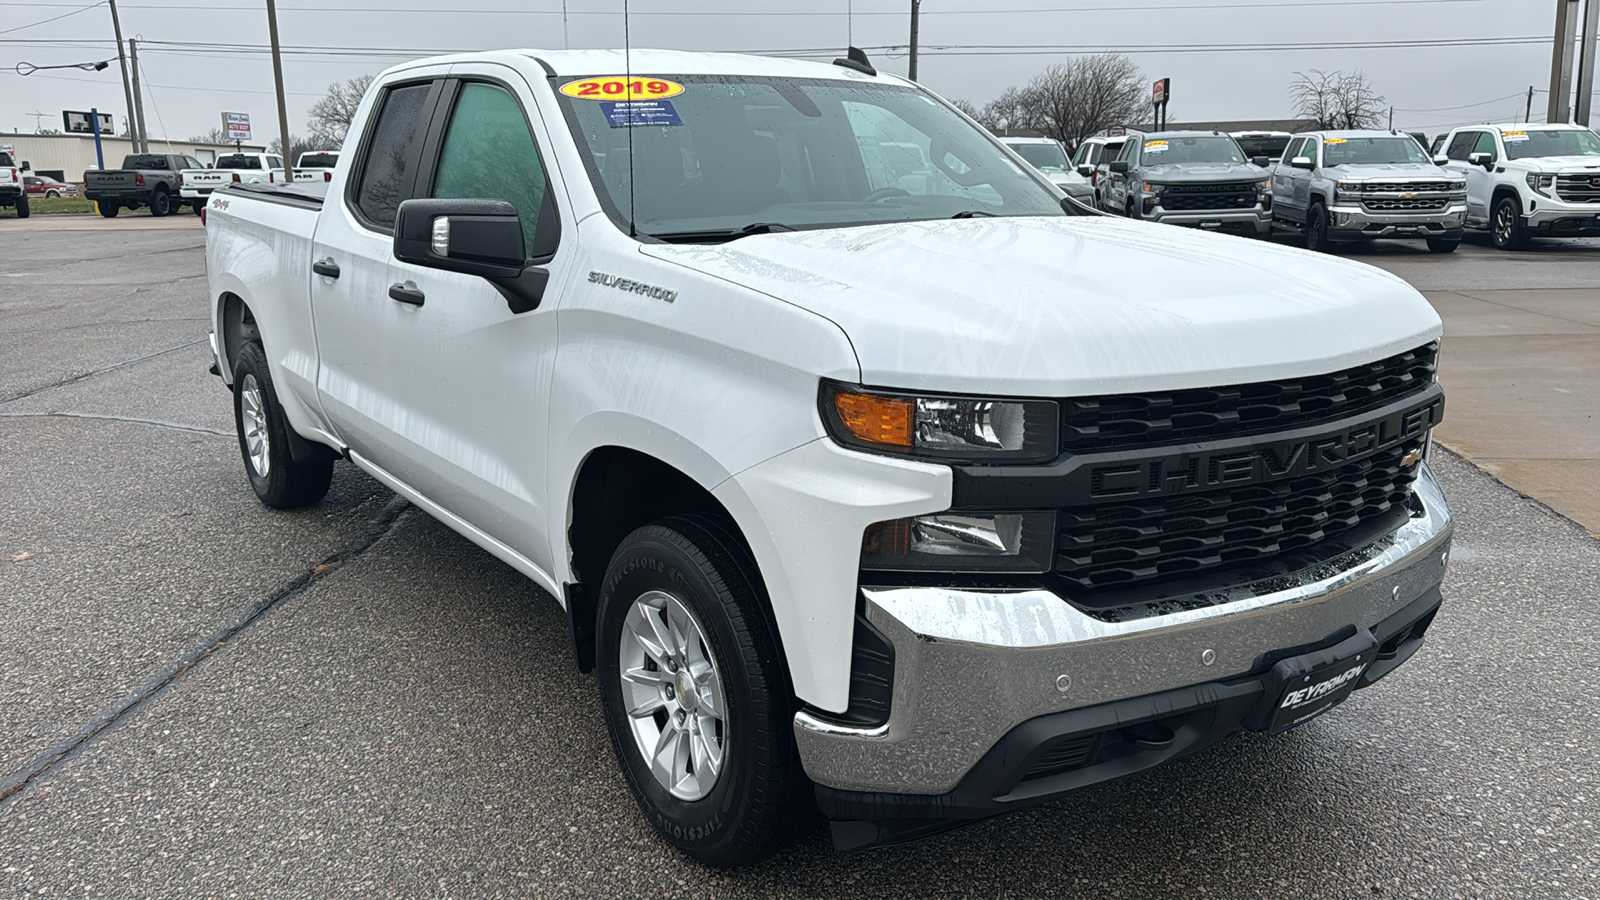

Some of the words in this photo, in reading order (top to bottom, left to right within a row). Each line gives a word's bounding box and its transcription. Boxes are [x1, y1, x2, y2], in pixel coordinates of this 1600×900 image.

[577, 81, 670, 96] 2019
[587, 270, 679, 304] SILVERADO
[1091, 398, 1443, 498] CHEVROLET
[1279, 662, 1368, 709] DEYARMAN
